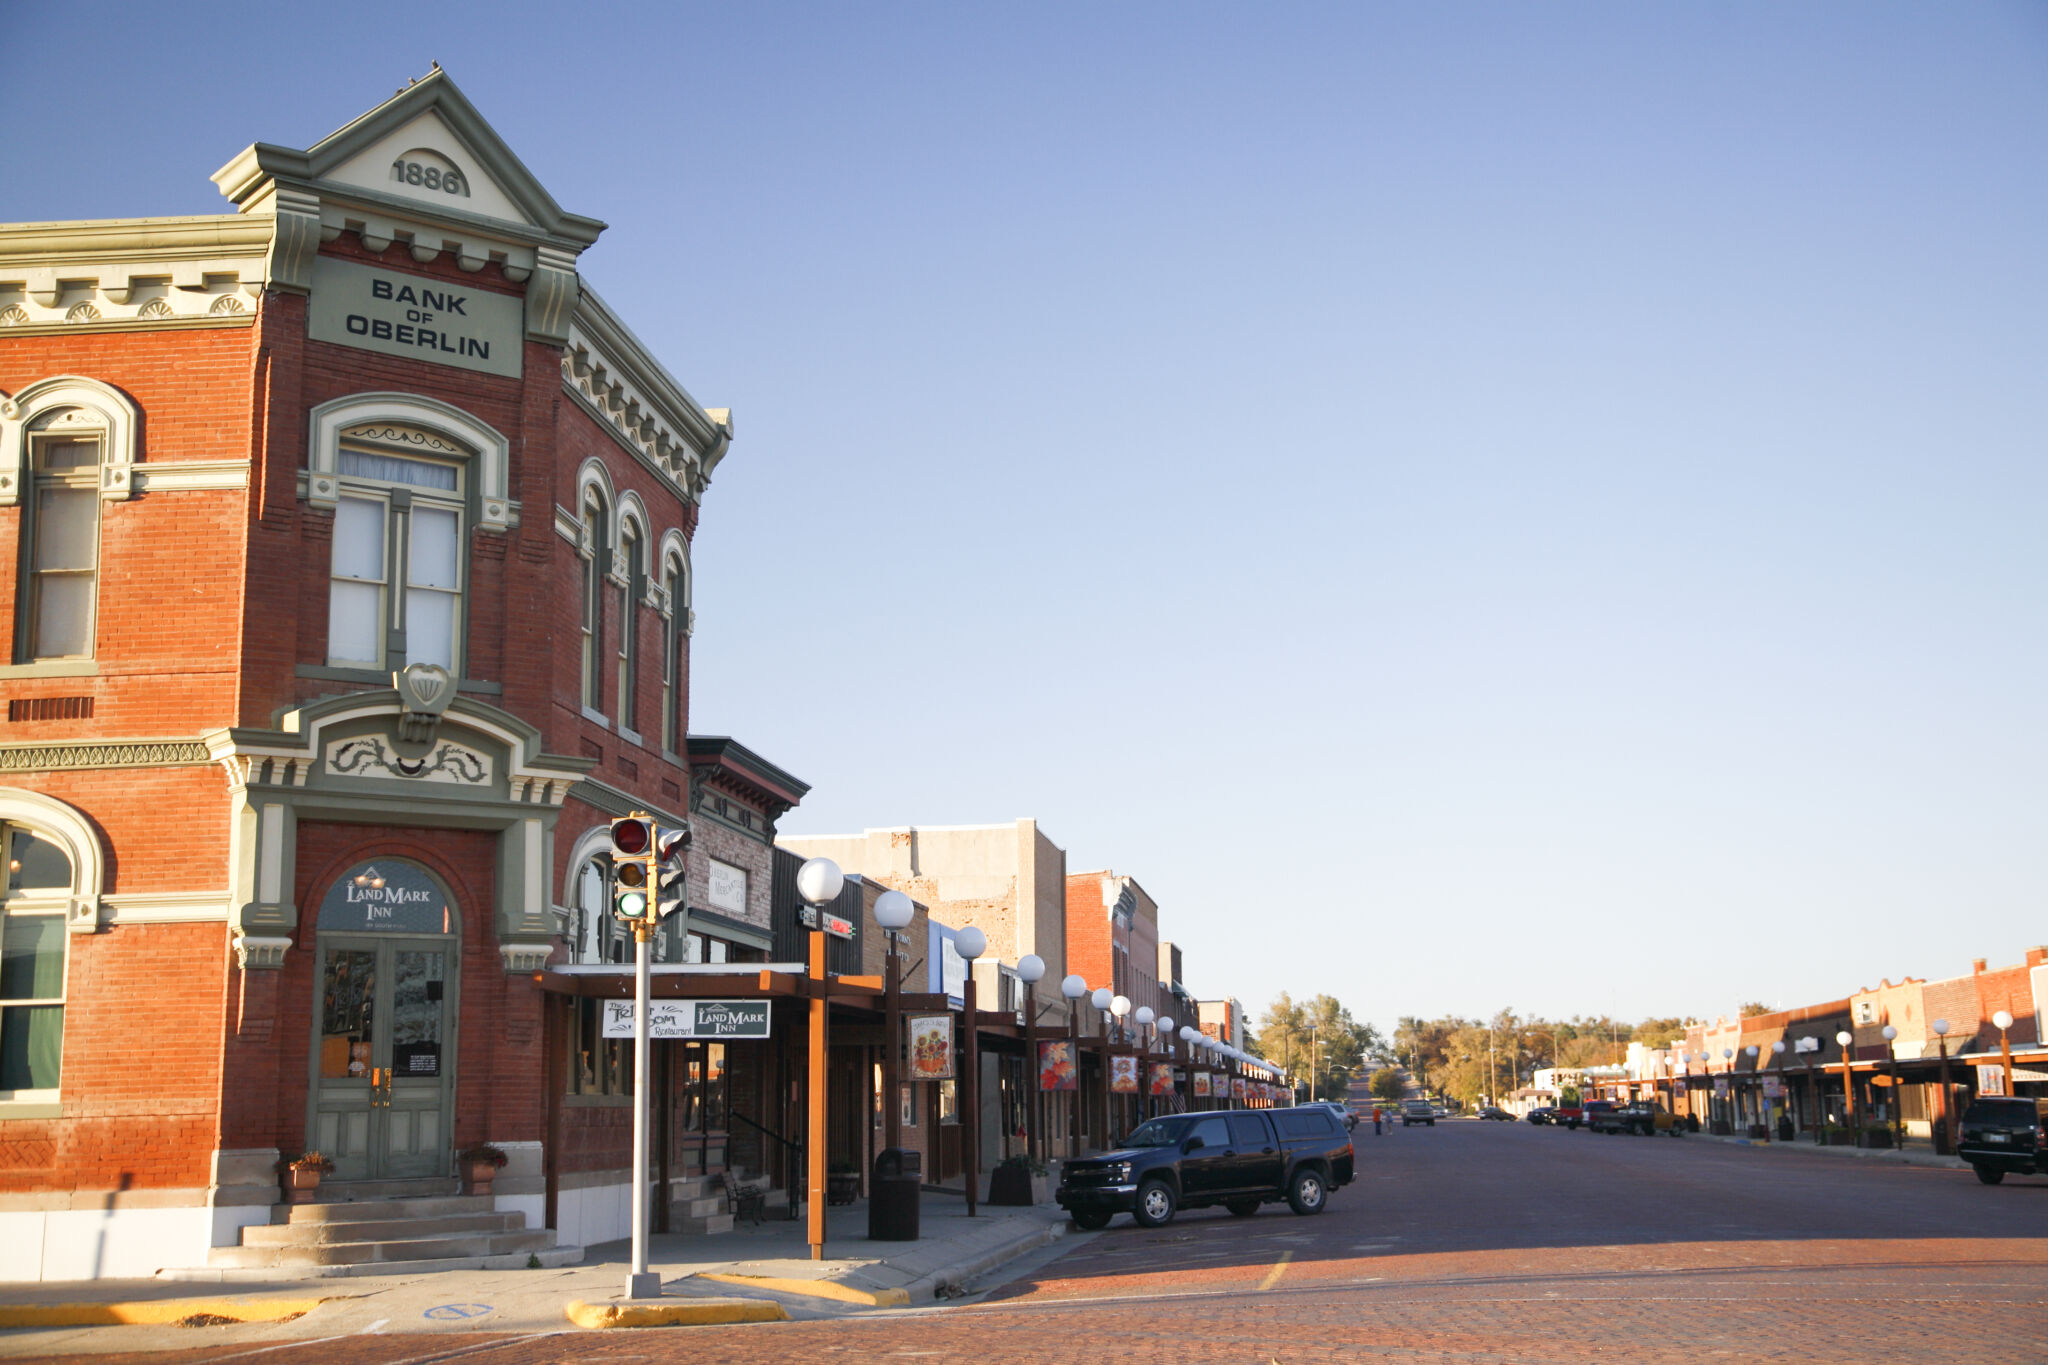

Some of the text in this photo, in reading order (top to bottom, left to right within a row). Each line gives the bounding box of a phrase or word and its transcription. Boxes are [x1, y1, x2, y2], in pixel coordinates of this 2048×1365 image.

[393, 160, 460, 194] 1886
[372, 278, 467, 316] BANK
[406, 309, 433, 324] OF
[346, 314, 490, 360] OBERLIN
[655, 1026, 692, 1037] Restaurant
